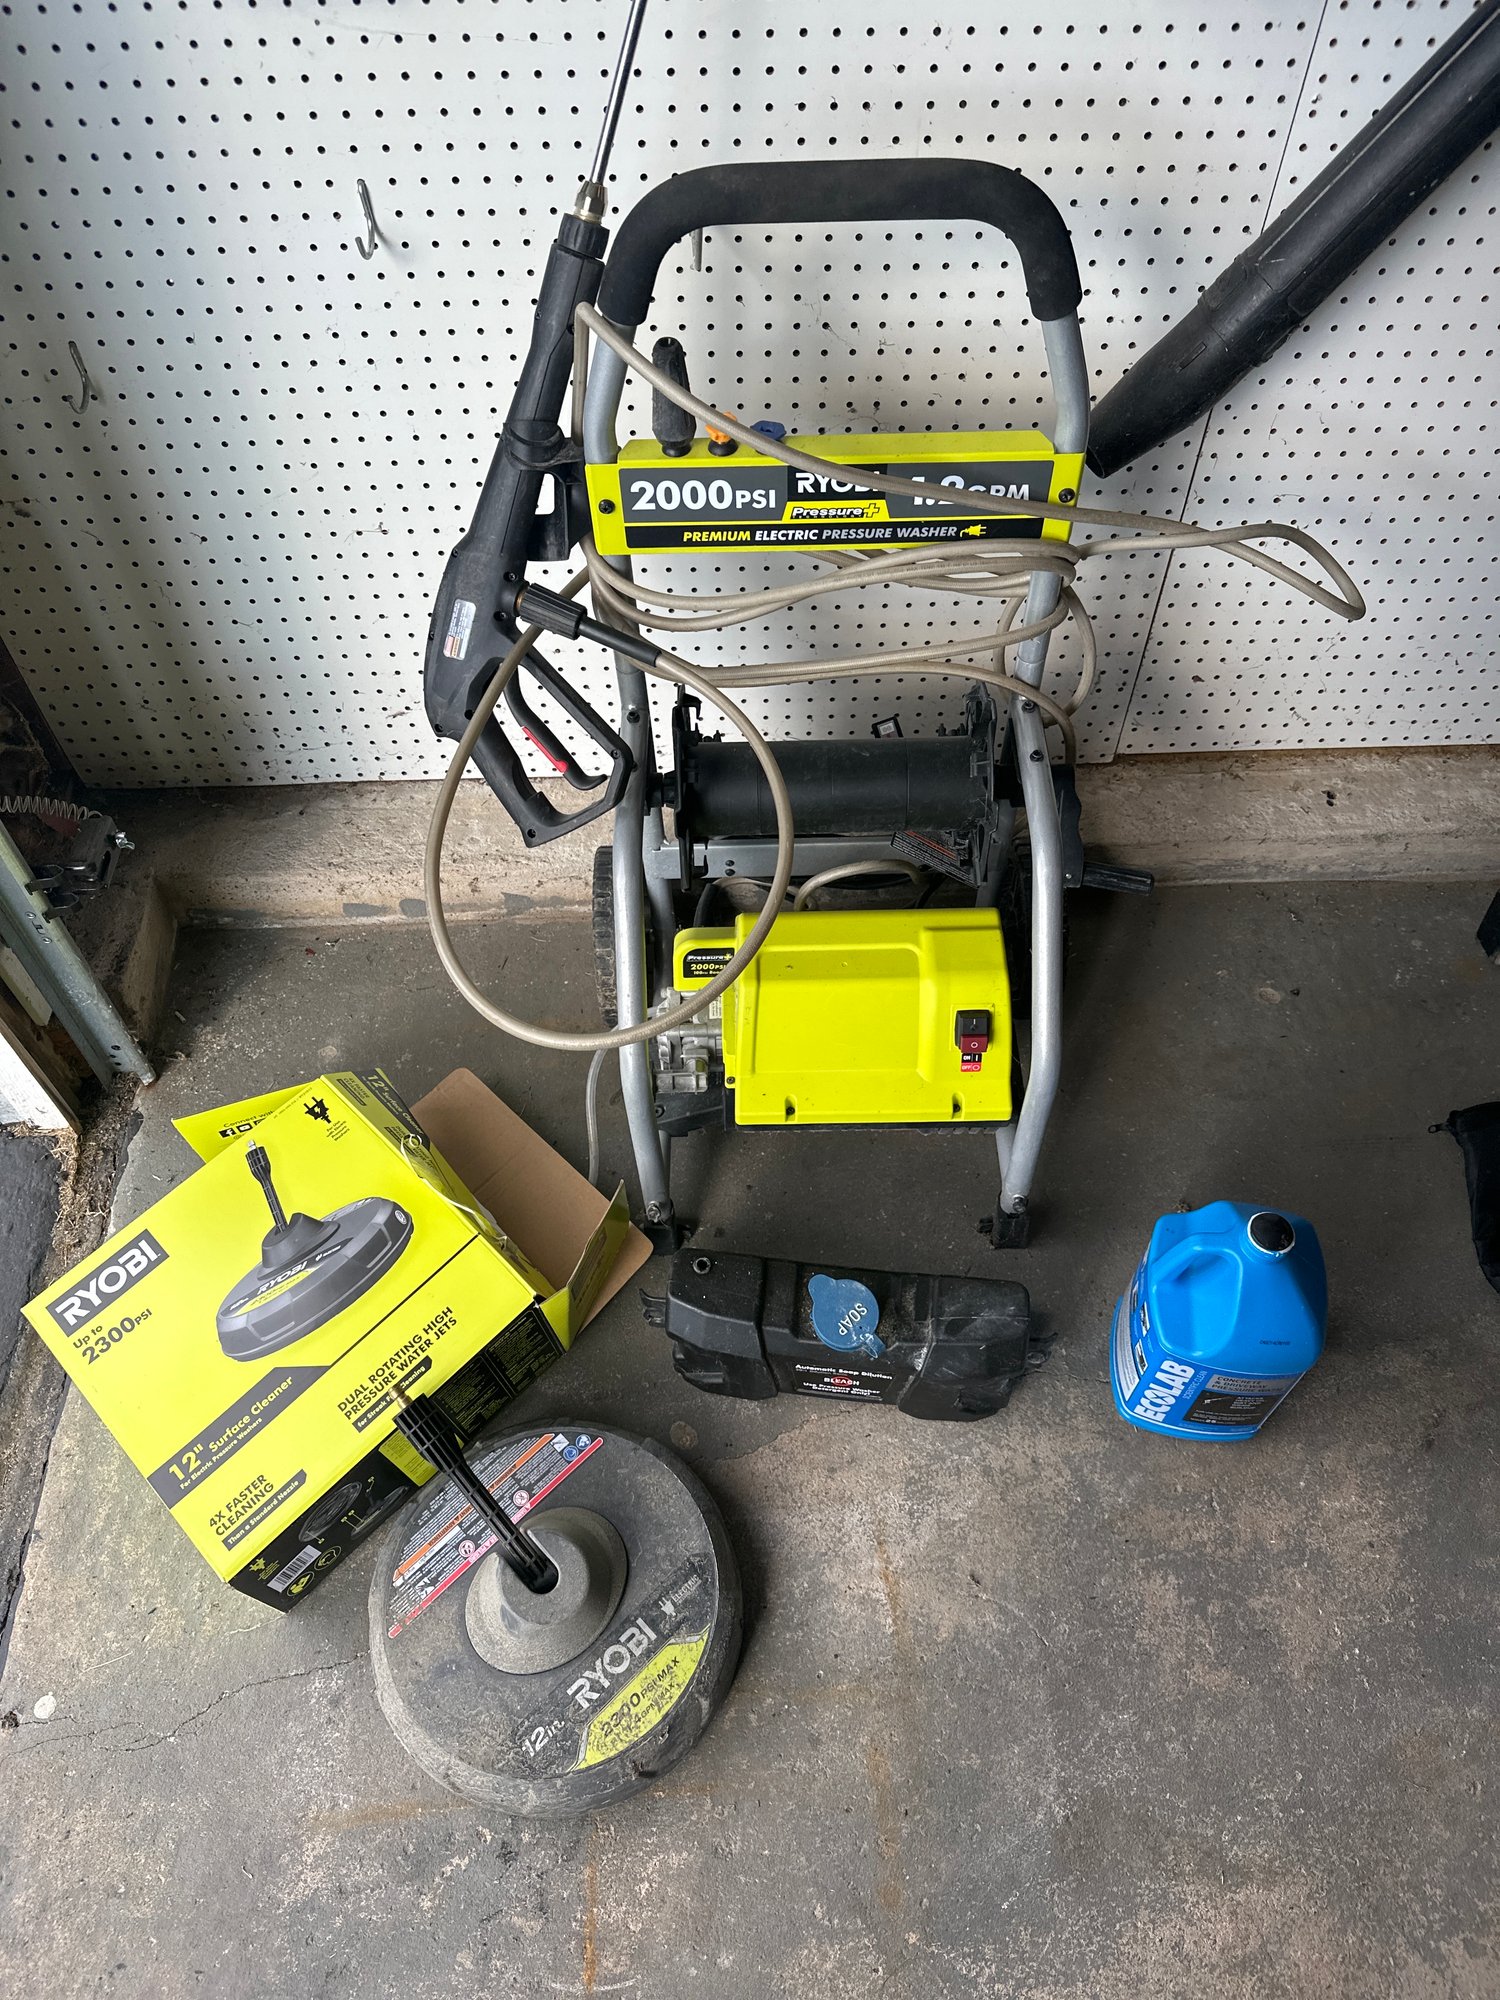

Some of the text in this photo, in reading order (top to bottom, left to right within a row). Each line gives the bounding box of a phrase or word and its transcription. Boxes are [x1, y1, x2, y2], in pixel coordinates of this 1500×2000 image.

[630, 480, 776, 511] 2000PSI
[683, 526, 957, 542] PREMIUM ELECTRIC PRESSURE WASHER
[223, 1116, 257, 1128] Connect
[55, 1239, 159, 1327] RYOBI
[257, 1261, 308, 1295] RYOBI
[72, 1325, 103, 1349] Up to
[82, 1308, 153, 1365] 2300PSI
[838, 1303, 868, 1336] SOAP
[337, 1306, 453, 1412] DUAL ROTATING HIGH
[344, 1370, 398, 1420] PRESSURE
[396, 1338, 434, 1372] WATER
[433, 1317, 457, 1341] JETS
[795, 1364, 836, 1373] Automatic
[861, 1371, 893, 1380] Dilution
[824, 1377, 860, 1386] BLEACH
[367, 1399, 388, 1420] Streak
[1133, 1360, 1195, 1422] ECOLAB
[168, 1376, 294, 1480] 12" Surface Cleaner
[180, 1417, 263, 1490] For Electric Pressure Washers
[209, 1474, 267, 1527] 4X FASTER
[215, 1482, 274, 1536] CLEANING
[227, 1529, 245, 1545] Than
[249, 1498, 278, 1526] Standard
[277, 1480, 299, 1501] Nozzle
[566, 1617, 657, 1710] RYOBI
[657, 1656, 680, 1682] MAX
